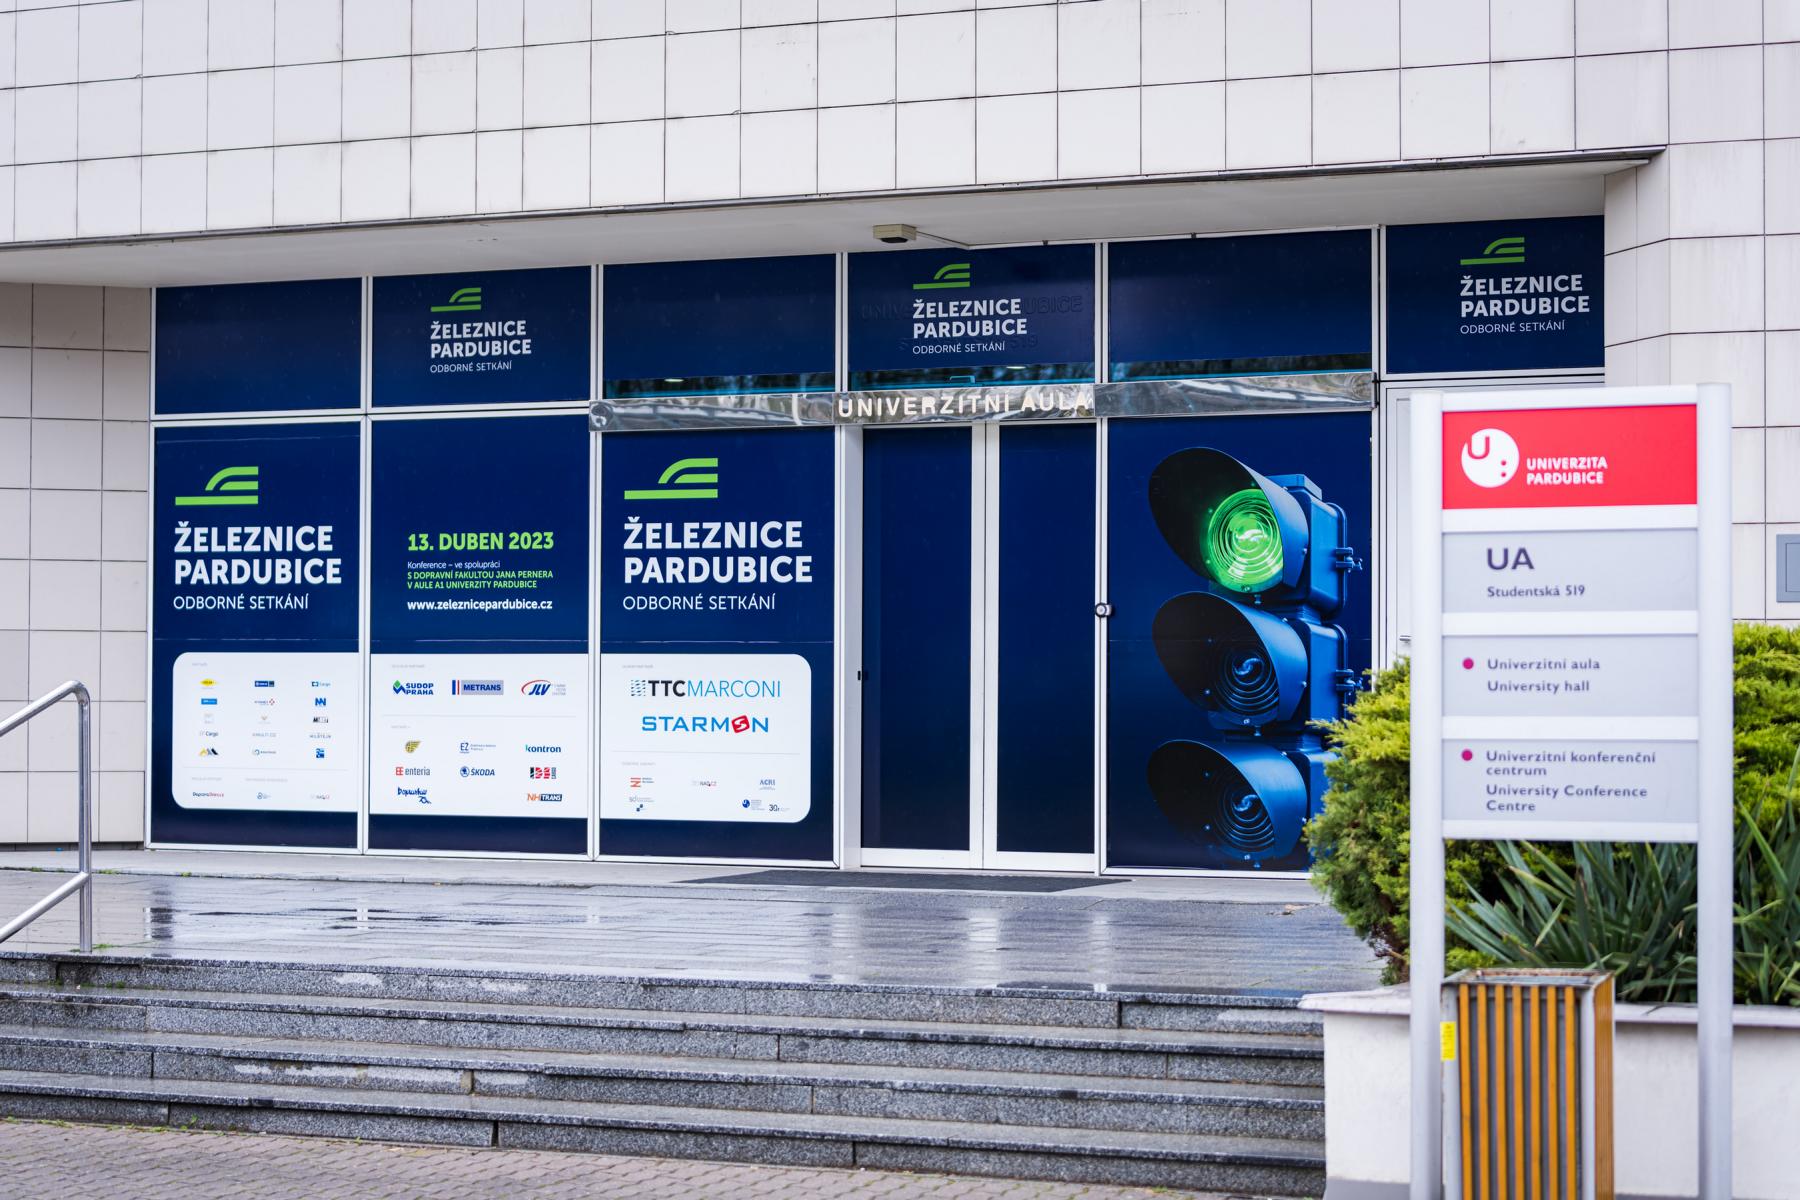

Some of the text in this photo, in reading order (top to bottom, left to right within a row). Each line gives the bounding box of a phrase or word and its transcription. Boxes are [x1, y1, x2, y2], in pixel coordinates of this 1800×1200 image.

[1459, 274, 1583, 297] ŽELEZNICE
[912, 298, 1022, 319] ŽELEZNICE
[1460, 295, 1590, 318] PARDUBICE
[430, 320, 527, 340] ŽELEZNICE
[912, 318, 1028, 339] PARDUBICE
[1459, 320, 1564, 334] ODBORNÉ SETKÁNÍ
[430, 338, 532, 359] PARDUBICE
[912, 343, 961, 354] ODBORNÉ
[964, 341, 1005, 352] SETKÁNÍ
[429, 360, 512, 373] ODBORNÉ SETKÁNÍ
[1020, 391, 1087, 412] AULA
[1526, 456, 1608, 471] UNIVERZITA
[1526, 472, 1604, 486] PARDUBICE
[173, 521, 333, 552] ŽELEZNICE
[623, 516, 803, 549] ŽELEZNICE
[407, 532, 553, 551] 13. DUBEN 2023
[407, 561, 446, 569] Konference
[464, 560, 501, 571] spolupráci
[1487, 548, 1534, 570] UA
[174, 558, 341, 584] PARDUBICE
[413, 570, 453, 579] DOPRAVNÍ
[454, 571, 494, 579] FAKULTOU
[624, 556, 812, 583] PARDUBICE
[413, 581, 433, 589] AULE
[1487, 585, 1585, 597] Studentská 519
[173, 593, 308, 609] ODBORNÉ SETKÁNÍ
[407, 599, 553, 611] www.zeleznicepardubice.cz
[622, 593, 775, 610] ODBORNÉ SETKÁNÍ
[1487, 659, 1600, 669] Univerzitní aula
[463, 683, 502, 692] METRANS
[528, 683, 552, 695] JLV
[1487, 681, 1589, 694] University hall
[525, 744, 561, 754] kontron
[1486, 751, 1655, 762] Univerzitní konferenční
[405, 766, 430, 776] enteria
[470, 767, 495, 777] ŠKODA
[1485, 767, 1546, 775] centrum
[1486, 785, 1647, 798] University Conference
[1485, 800, 1535, 811] Centre
